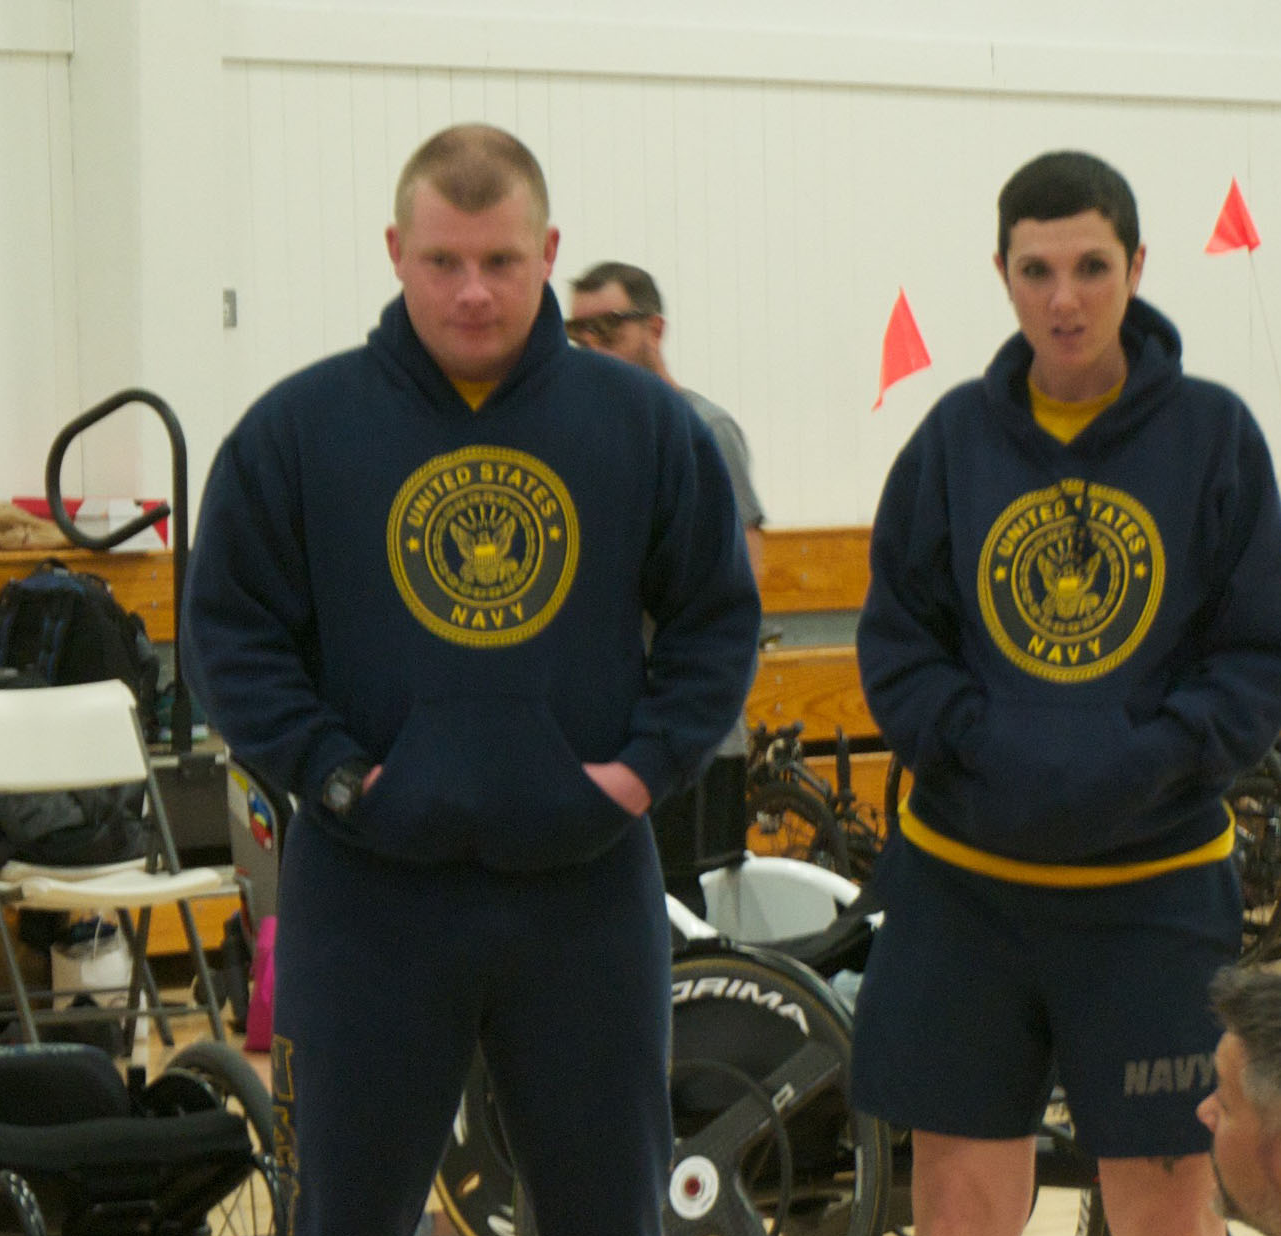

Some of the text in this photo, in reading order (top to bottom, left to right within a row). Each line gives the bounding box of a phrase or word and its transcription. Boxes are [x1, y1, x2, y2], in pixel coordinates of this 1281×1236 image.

[407, 462, 557, 527] UNITED STATES
[998, 500, 1065, 557] UNITED
[451, 602, 523, 629] NAVY
[1028, 634, 1100, 664] NAVY
